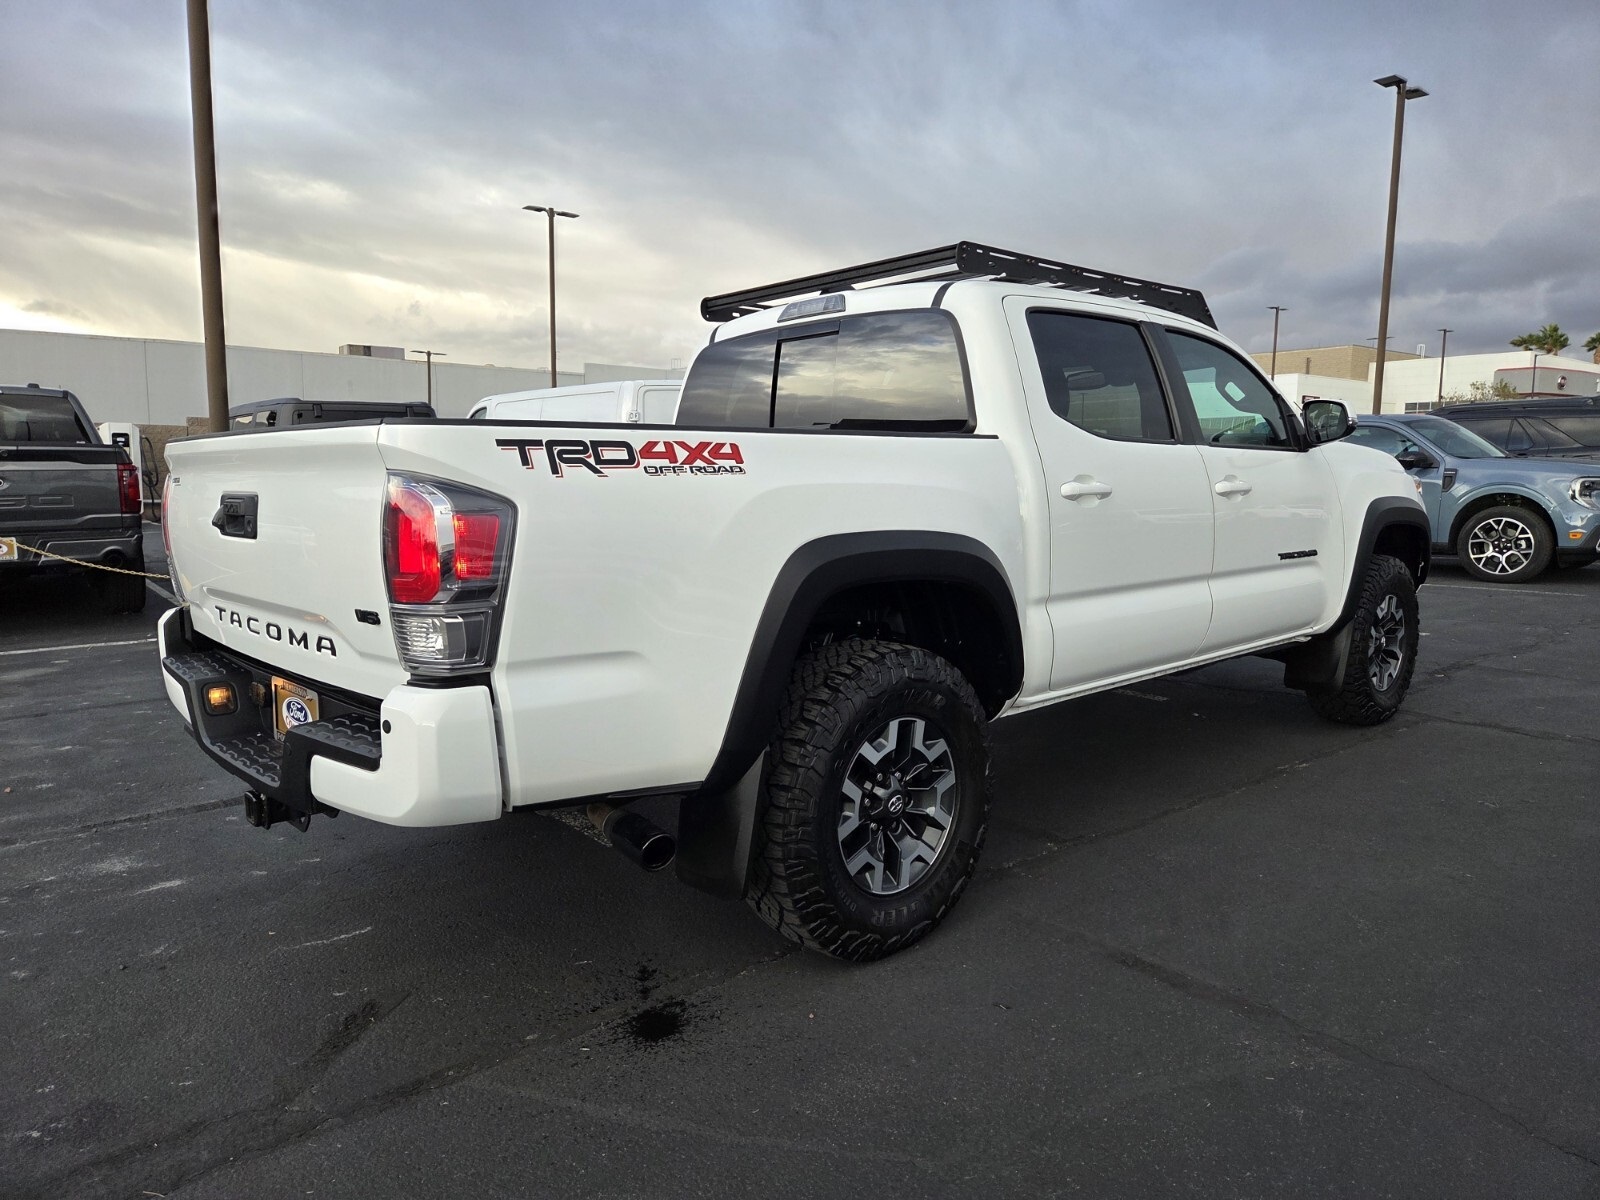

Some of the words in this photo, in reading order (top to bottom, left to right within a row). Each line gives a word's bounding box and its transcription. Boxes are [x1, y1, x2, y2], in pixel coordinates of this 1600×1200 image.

[495, 438, 641, 478] TRD
[638, 440, 744, 465] 4X4
[644, 465, 686, 477] OFF
[688, 465, 747, 476] ROAD
[354, 608, 381, 625] V6
[214, 604, 338, 657] TACOMA
[289, 701, 306, 721] Ford
